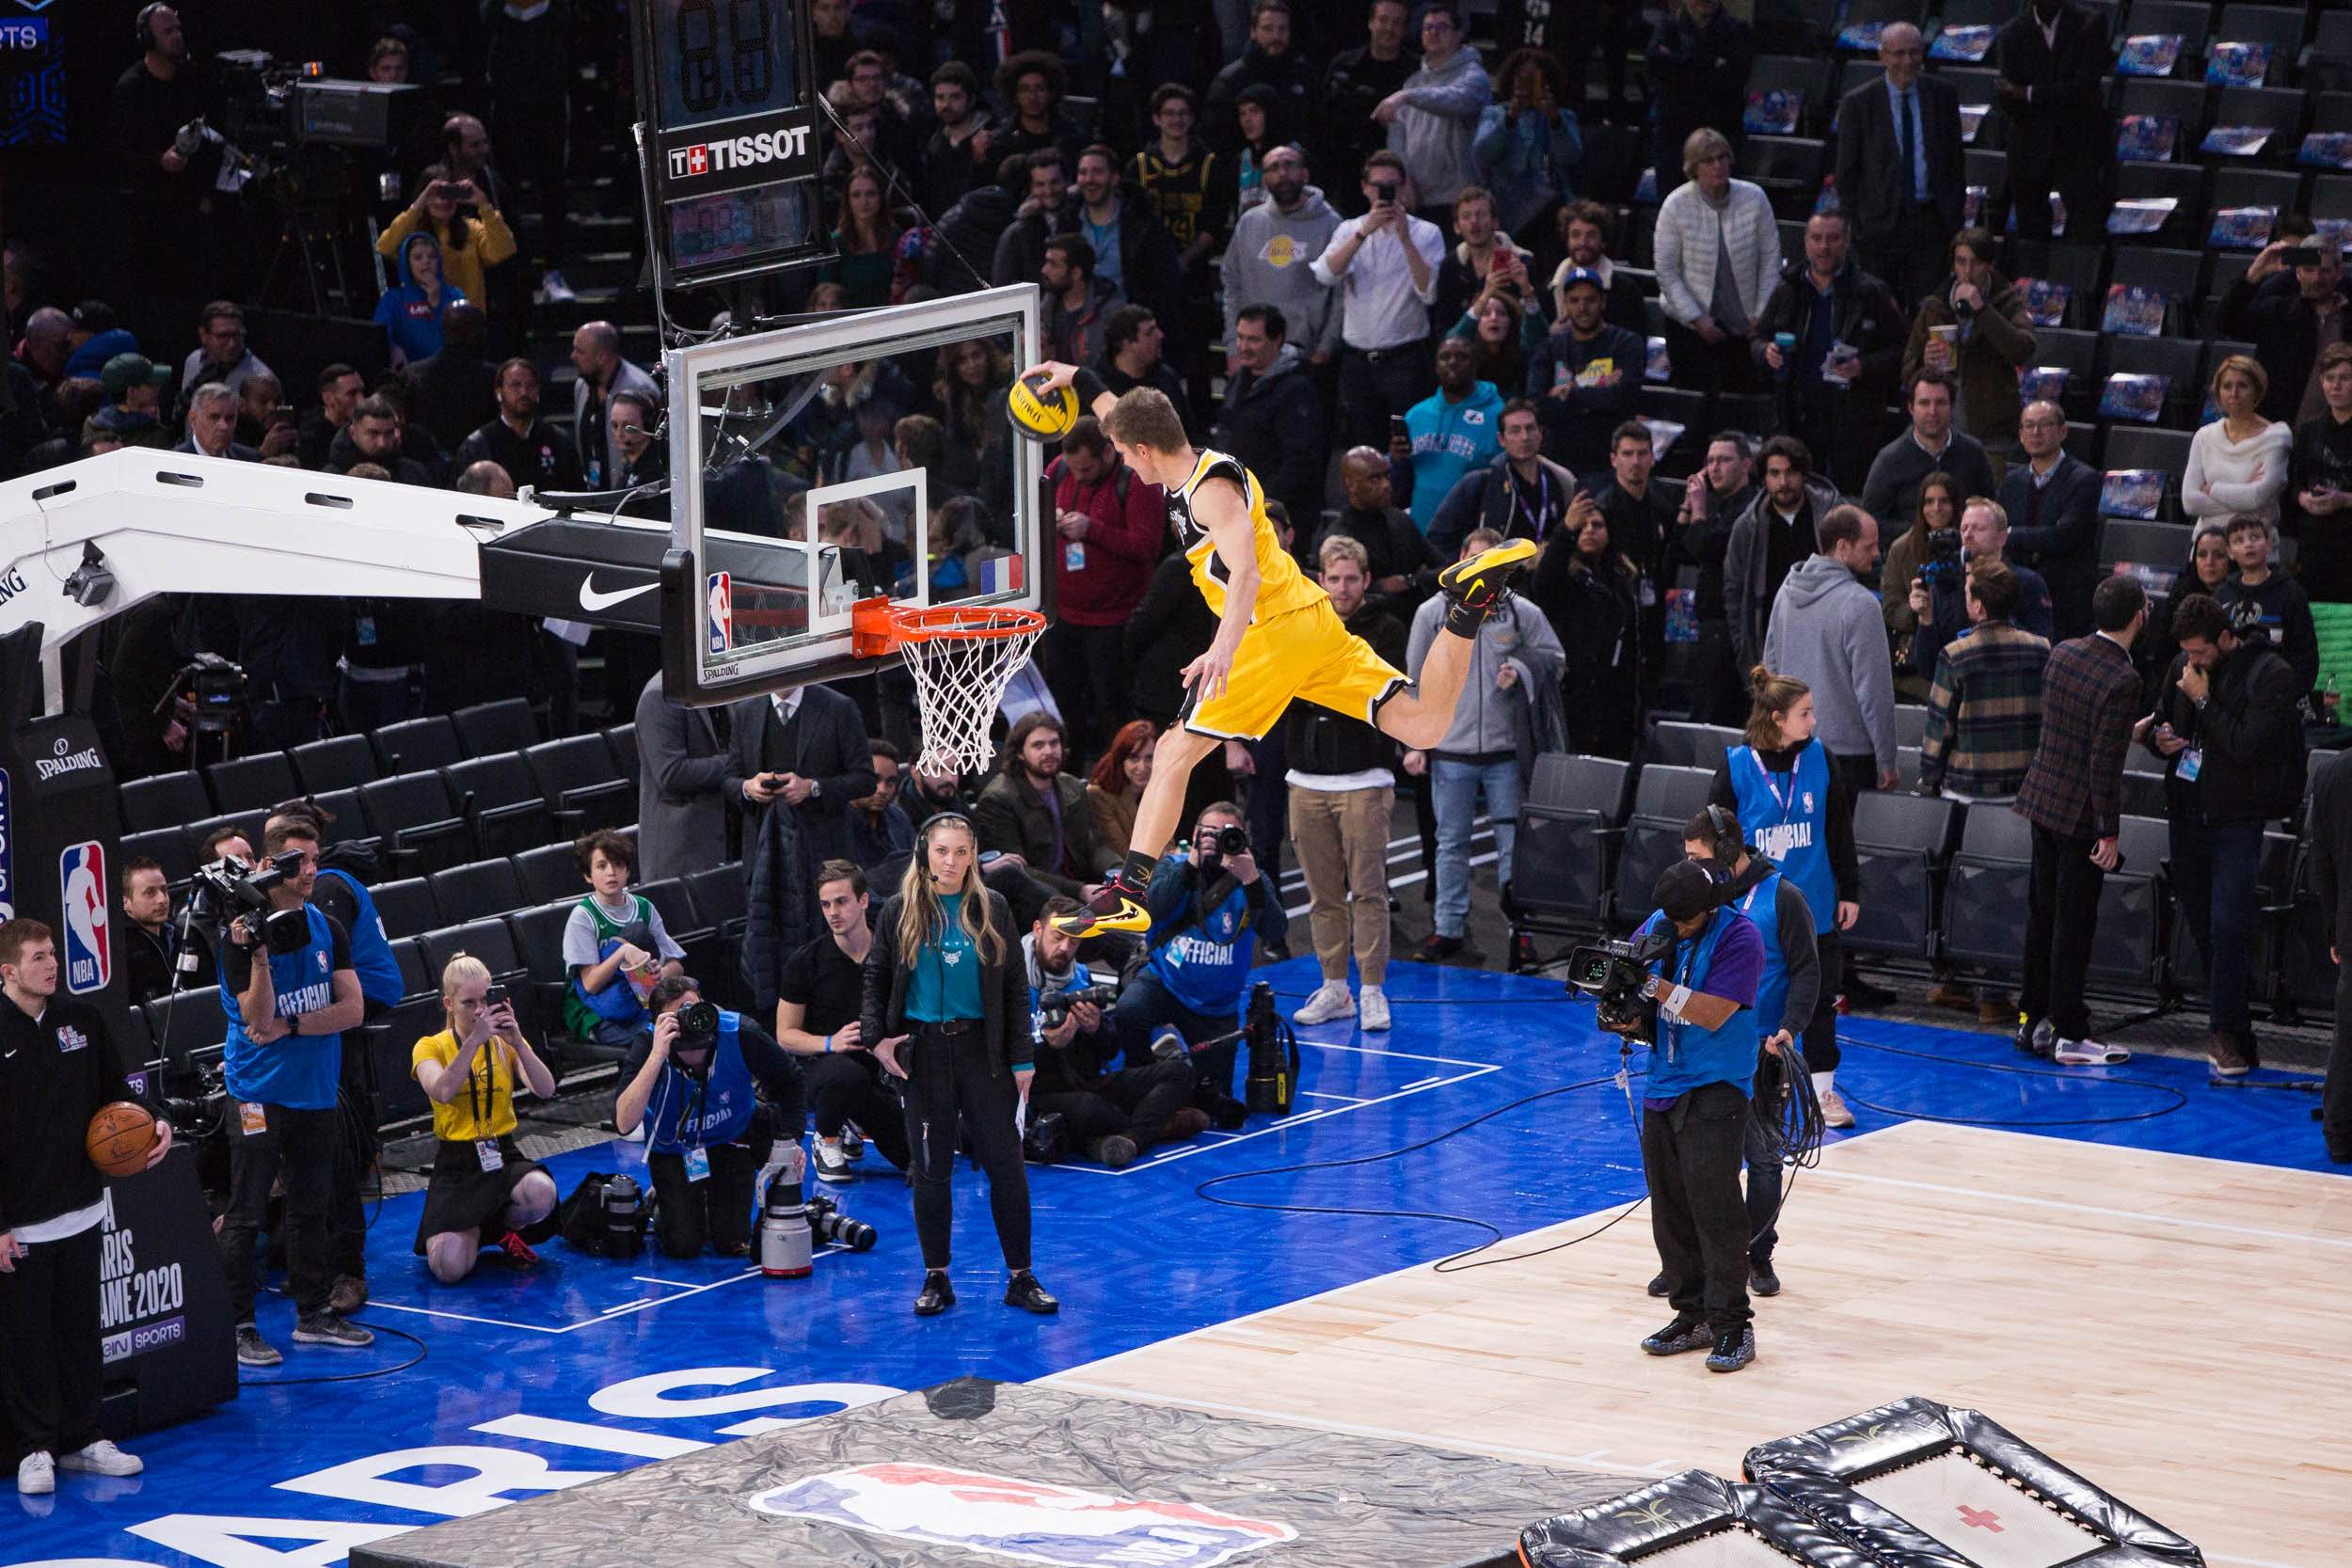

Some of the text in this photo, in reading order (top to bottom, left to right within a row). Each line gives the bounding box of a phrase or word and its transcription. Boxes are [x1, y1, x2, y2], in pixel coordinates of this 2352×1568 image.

[707, 125, 811, 171] TISSOT
[0, 566, 26, 607] NG
[711, 636, 723, 650] NBA
[704, 663, 739, 682] SPALDING
[35, 748, 102, 781] SPALDING
[1184, 939, 1233, 966] FFICIAL
[72, 958, 95, 985] NBA
[134, 1262, 184, 1320] 2020
[135, 1323, 182, 1349] SPORTS
[0, 1367, 909, 1568] ARIS
